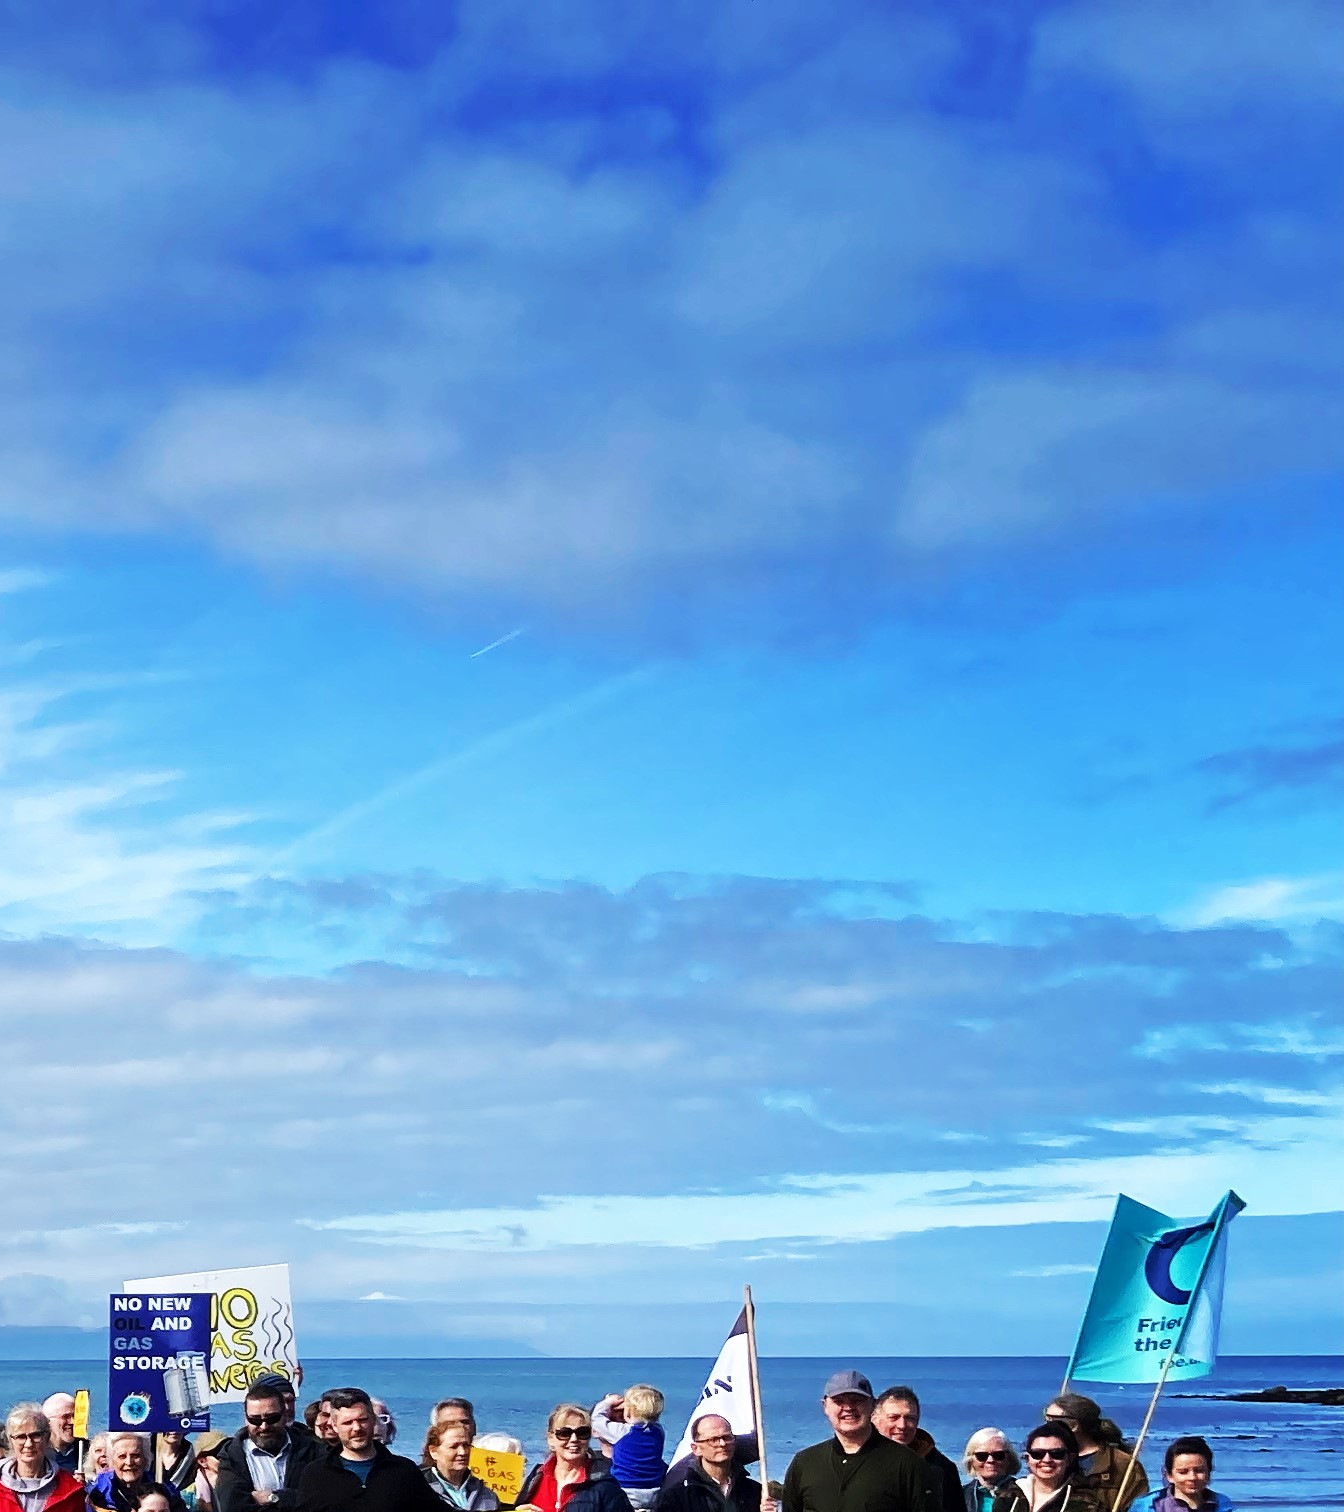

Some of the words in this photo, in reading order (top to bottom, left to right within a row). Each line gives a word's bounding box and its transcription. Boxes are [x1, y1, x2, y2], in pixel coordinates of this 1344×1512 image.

[114, 1298, 142, 1311] NO
[148, 1298, 191, 1311] NEW
[210, 1287, 259, 1332] O
[114, 1317, 145, 1331] OIL
[151, 1317, 192, 1331] AND
[114, 1337, 153, 1350] GAS
[210, 1330, 258, 1361] AS
[1134, 1338, 1172, 1352] the
[113, 1356, 204, 1370] STORAGE
[487, 1468, 515, 1481] GAS
